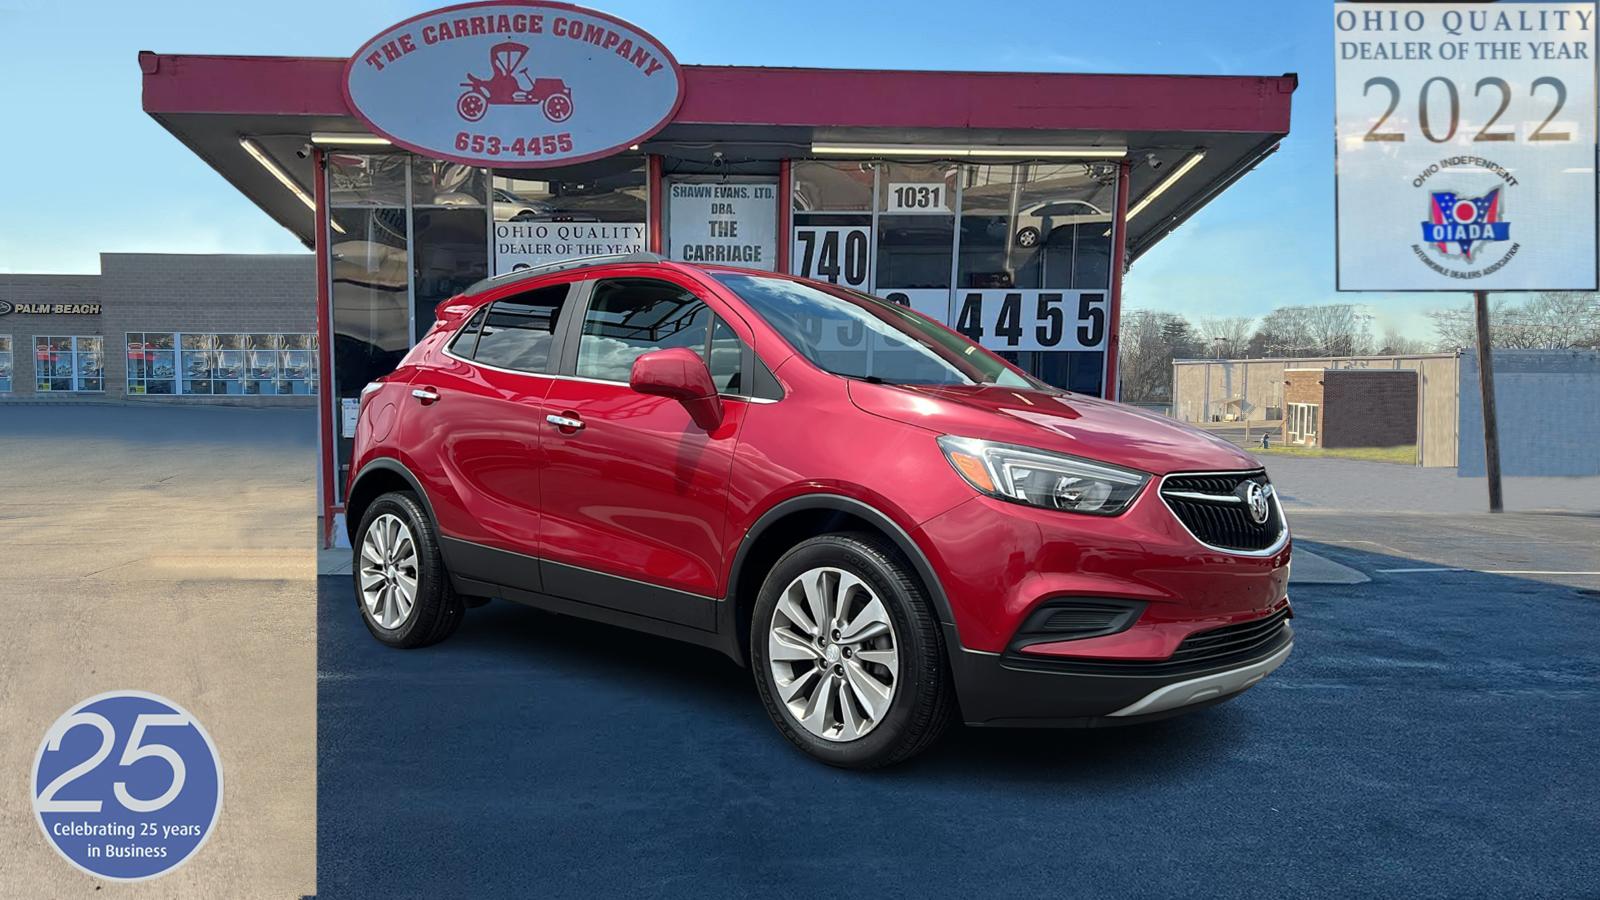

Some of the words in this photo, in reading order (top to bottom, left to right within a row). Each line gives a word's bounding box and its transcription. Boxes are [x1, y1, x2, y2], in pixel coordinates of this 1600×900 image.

[1336, 10, 1425, 32] OHIO
[1442, 10, 1593, 35] QUALITY
[366, 34, 416, 72] THE
[422, 14, 543, 45] CARRIAGE
[552, 17, 664, 77] COMPANY
[1340, 42, 1433, 60] DEALER
[1439, 42, 1469, 60] OF
[1475, 42, 1522, 60] THE
[1528, 42, 1589, 60] YEAR
[1363, 76, 1571, 143] 2022
[454, 132, 574, 157] 653-4455
[1412, 163, 1440, 189] OHIO
[1439, 155, 1519, 188] INDEPENDENT
[672, 184, 712, 199] SHAWN
[754, 185, 775, 200] LTD.
[894, 186, 941, 208] 1031
[711, 203, 736, 216] DBA.
[497, 226, 549, 239] OHIO
[557, 226, 645, 241] QUALITY
[709, 220, 738, 238] THE
[1432, 224, 1494, 240] OIADA
[499, 243, 552, 255] DEALER
[555, 243, 573, 255] OF
[576, 243, 603, 255] THE
[683, 244, 762, 263] CARRIAGE
[797, 230, 868, 285] 740
[1411, 244, 1450, 277] AUTOMOBILE
[1449, 270, 1483, 280] DEALERS
[1482, 242, 1521, 276] ASSOCIATION
[14, 303, 51, 314] PALM
[54, 304, 100, 314] BEACH
[957, 293, 1105, 347] 4455
